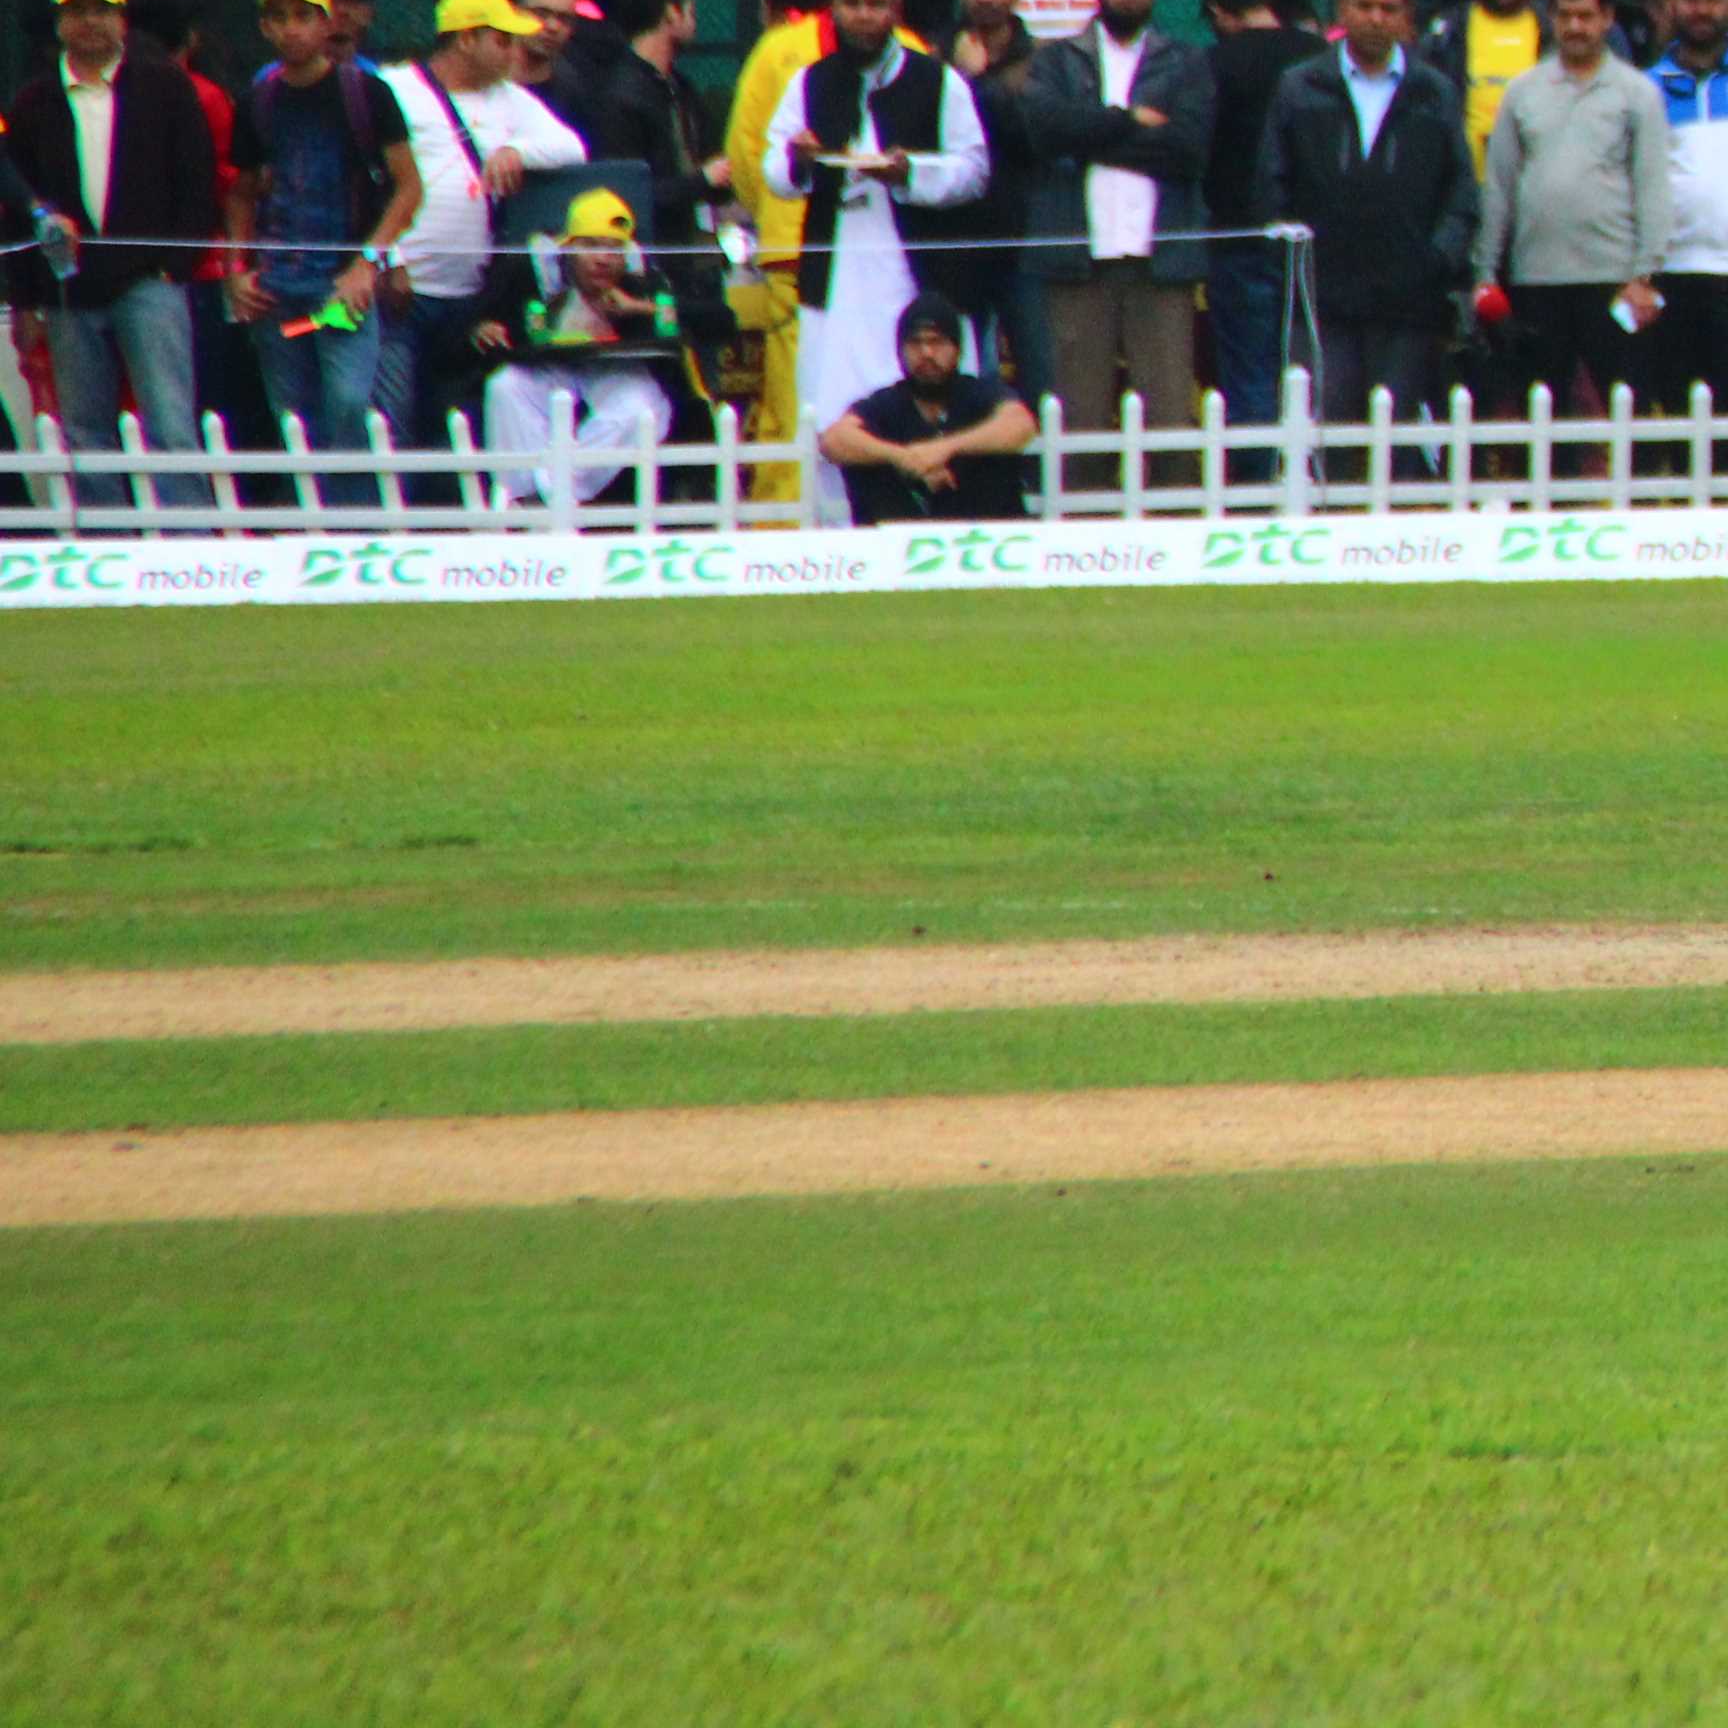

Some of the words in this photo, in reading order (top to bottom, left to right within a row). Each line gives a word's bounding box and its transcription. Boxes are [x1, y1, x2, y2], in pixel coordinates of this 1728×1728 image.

[138, 559, 265, 591] mobile
[441, 557, 567, 588] mobile
[743, 552, 867, 584] mobile
[1044, 545, 1168, 575] mobile
[1341, 536, 1464, 566] mobile
